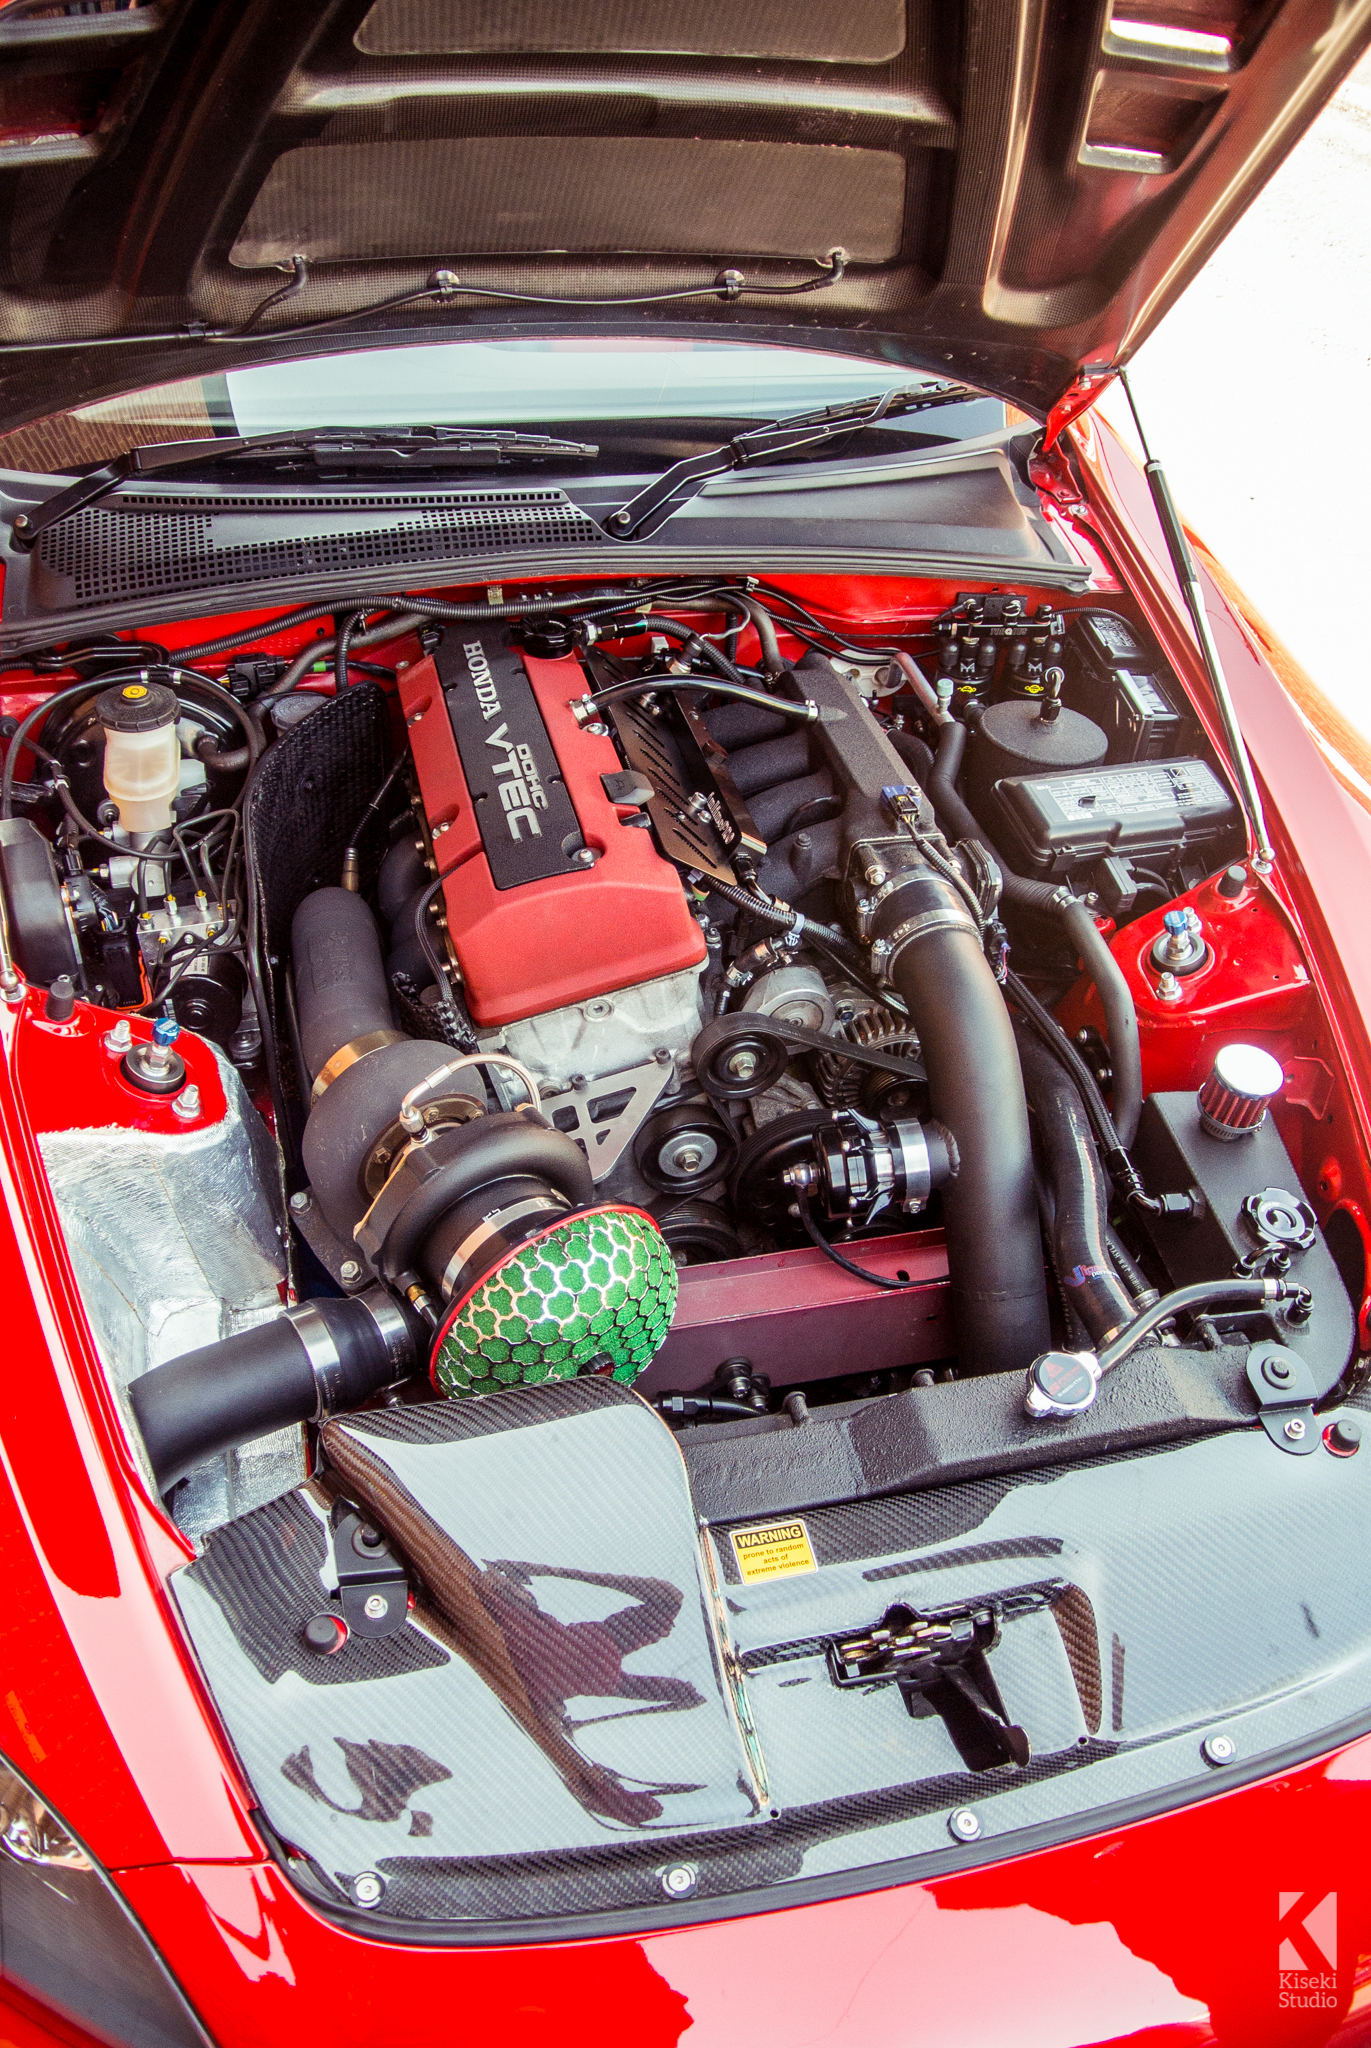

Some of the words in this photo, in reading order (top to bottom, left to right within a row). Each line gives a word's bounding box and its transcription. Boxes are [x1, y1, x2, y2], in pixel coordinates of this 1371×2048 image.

[463, 640, 502, 722] HONDA
[485, 722, 543, 844] VTEC
[516, 743, 549, 811] DOHC
[738, 1526, 801, 1548] WARNING
[743, 1550, 765, 1561] prone
[776, 1543, 804, 1553] random
[763, 1555, 779, 1564] acts
[781, 1553, 789, 1561] of
[747, 1566, 777, 1576] extreme
[778, 1559, 810, 1570] violence
